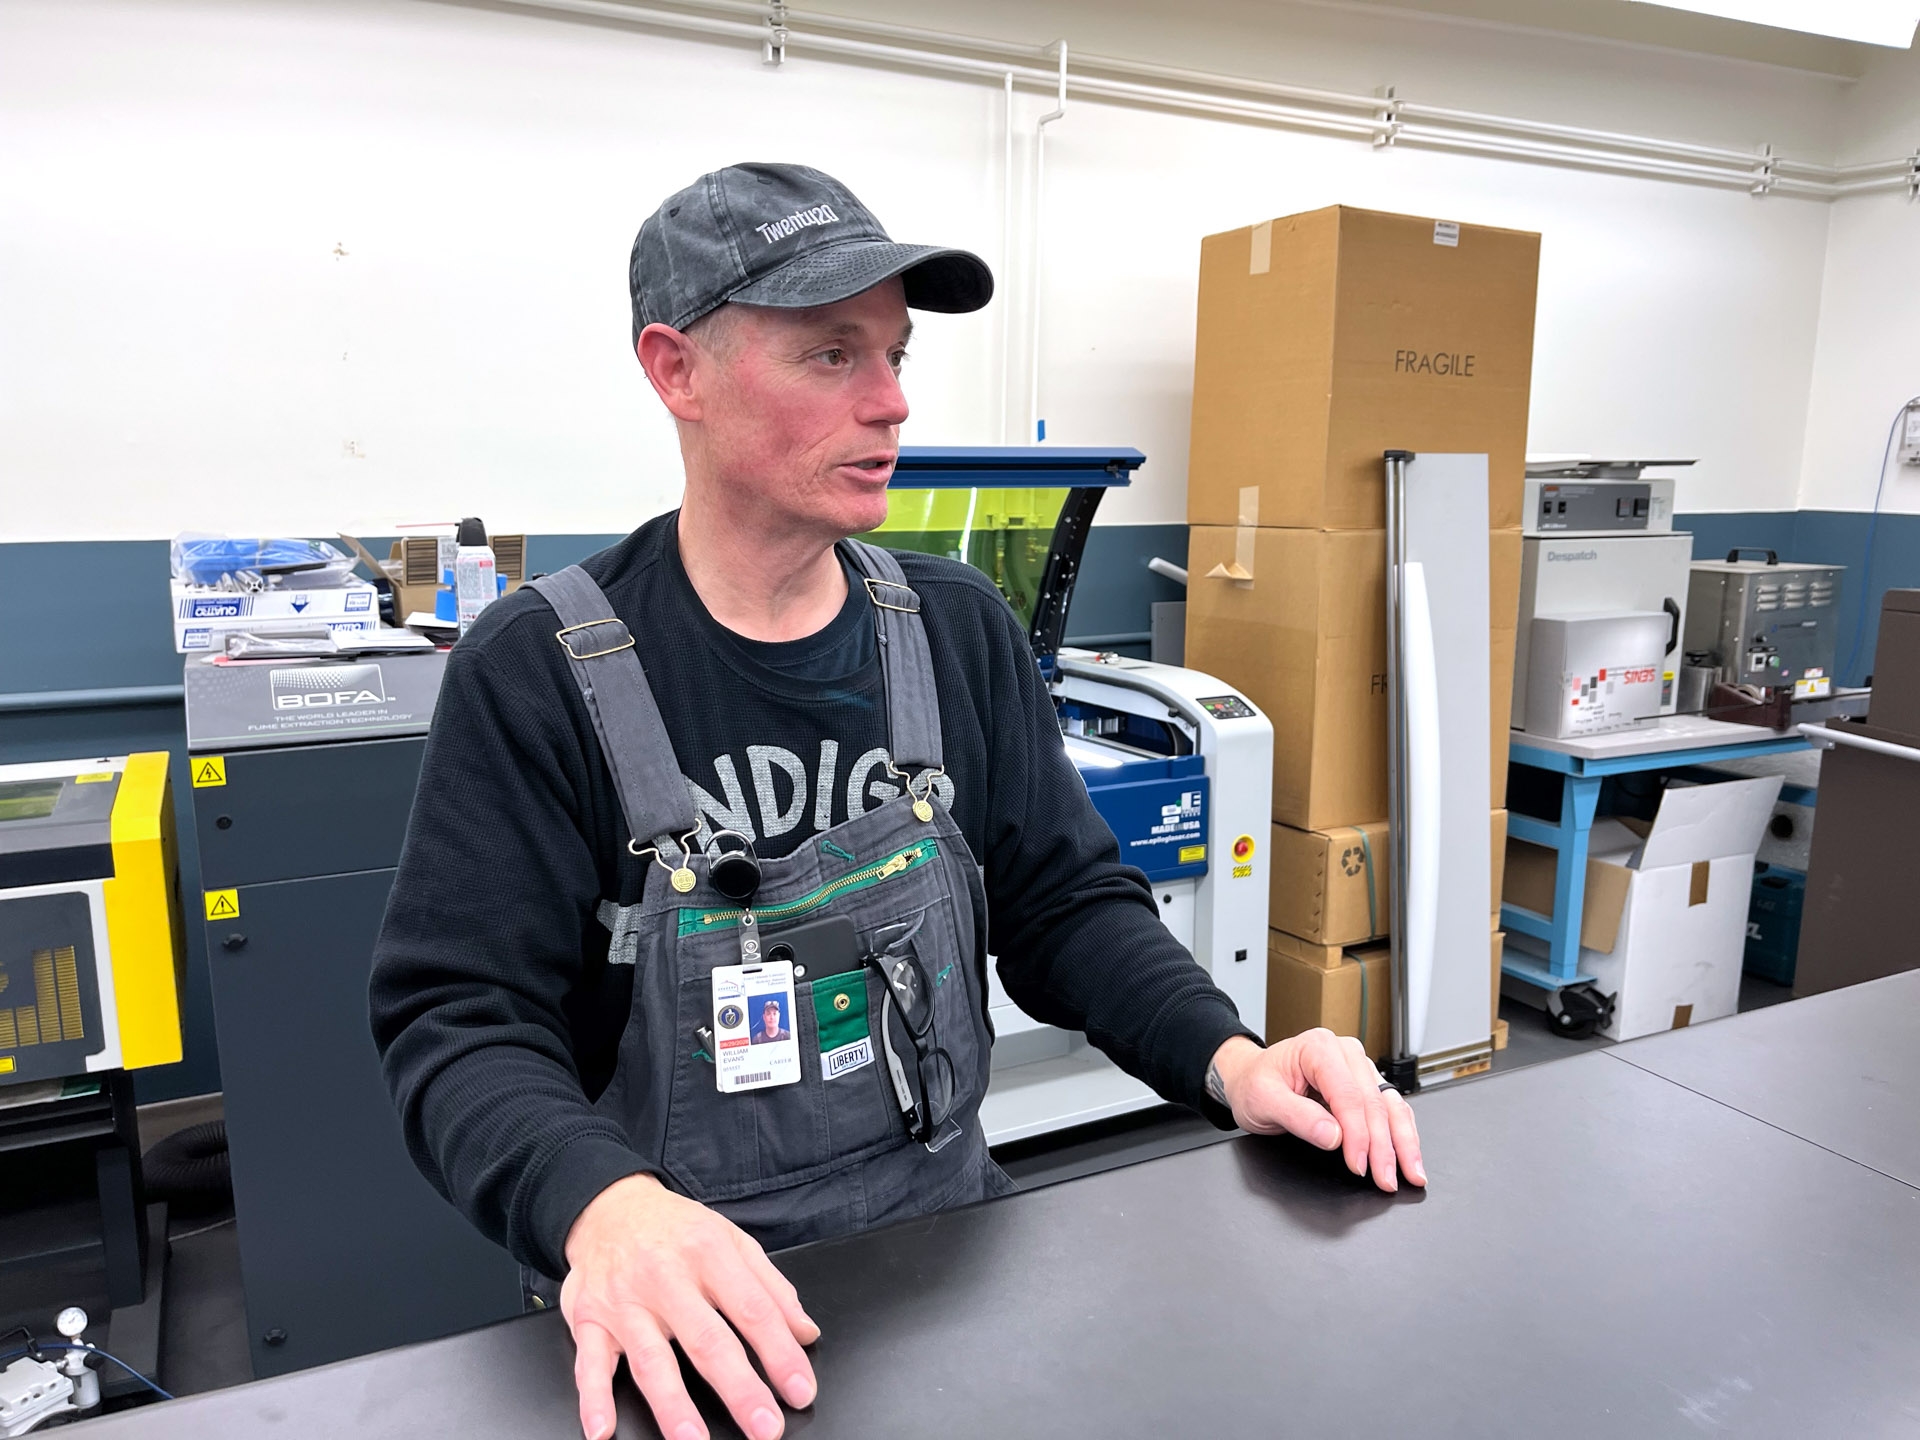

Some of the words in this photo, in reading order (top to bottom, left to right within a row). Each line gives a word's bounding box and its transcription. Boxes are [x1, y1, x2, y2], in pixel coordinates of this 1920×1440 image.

[755, 204, 840, 244] Twenty20
[1395, 350, 1475, 377] FRAGILE
[1547, 550, 1598, 562] Despatch
[194, 605, 238, 617] QUATTRO
[277, 690, 382, 709] BOFA
[248, 723, 279, 731] FUME
[280, 719, 345, 729] EXTRACTION
[345, 713, 413, 724] TECHNOLOGY
[274, 715, 297, 723] THE
[297, 712, 335, 721] WORLD
[336, 709, 376, 718] LEADER
[1151, 824, 1175, 834] MADE
[1183, 820, 1200, 830] USA
[722, 1048, 749, 1057] WILLIAM
[832, 1047, 864, 1070] LIBERTY
[723, 1056, 745, 1064] EVANS
